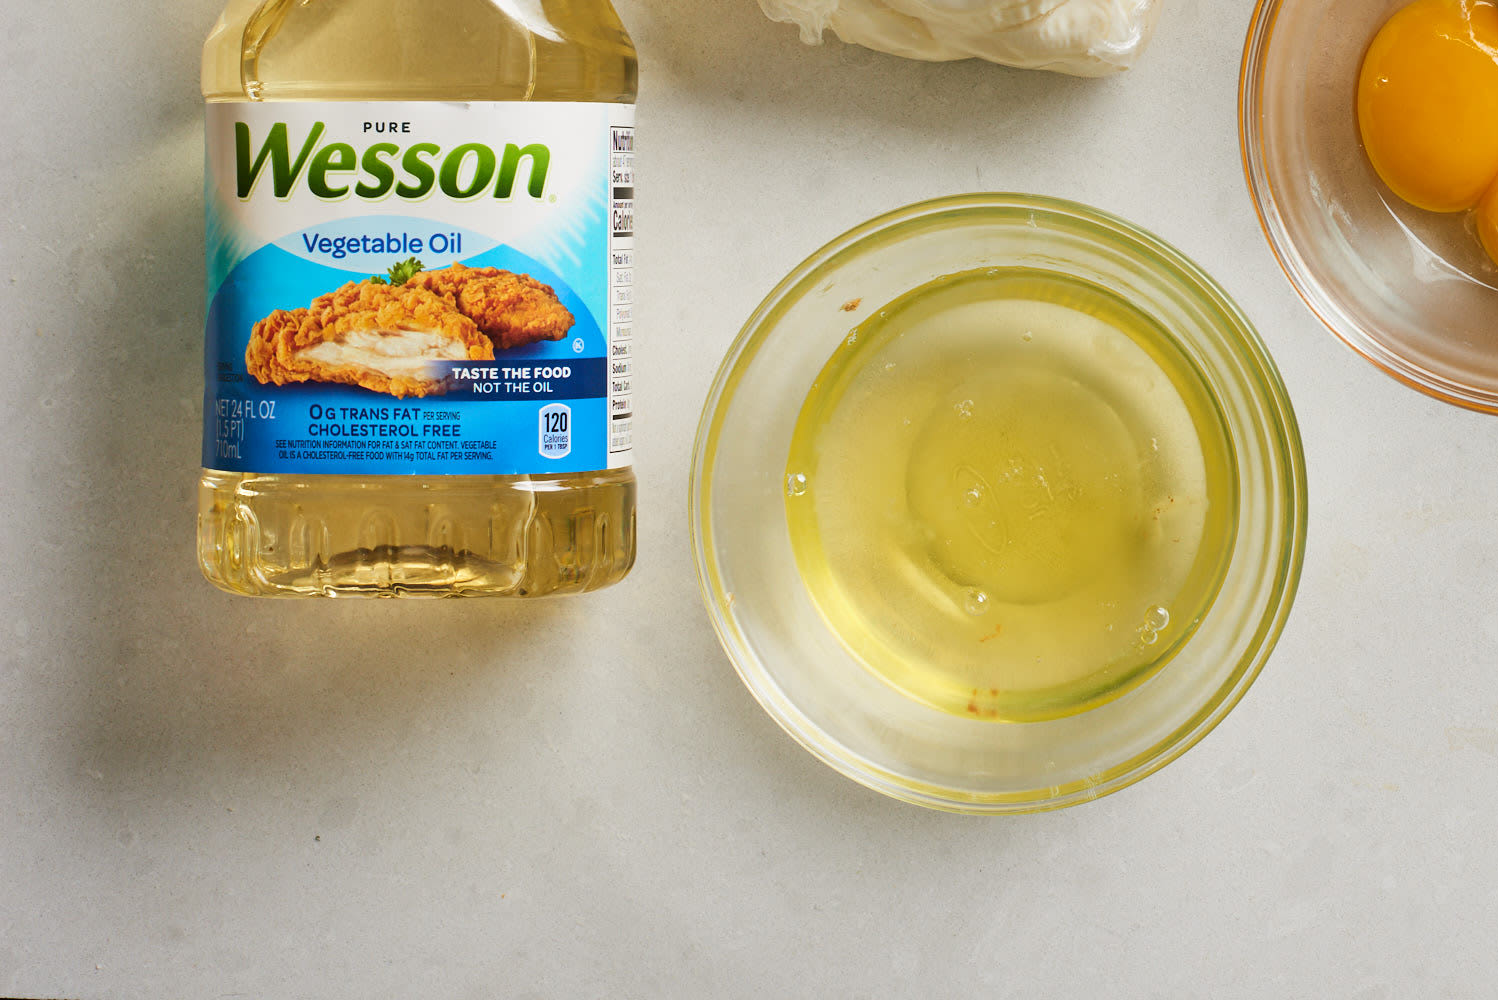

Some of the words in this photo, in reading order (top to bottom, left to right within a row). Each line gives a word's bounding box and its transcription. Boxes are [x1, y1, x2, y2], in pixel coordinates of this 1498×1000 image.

[363, 121, 411, 133] PURE
[234, 120, 552, 200] Wesson
[303, 231, 424, 259] Vegetable
[428, 231, 462, 254] Oil
[452, 367, 499, 380] TASTE
[501, 367, 531, 379] THE
[534, 366, 572, 379] FOOD
[473, 382, 501, 393] NOT
[504, 382, 530, 393] THE
[532, 381, 553, 393] OIL
[216, 399, 230, 417] NET
[231, 399, 243, 418] 24
[245, 400, 256, 418] FL
[259, 400, 276, 419] OZ
[339, 407, 389, 420] TRANS
[393, 407, 421, 420] FAT
[423, 411, 435, 421] PER
[436, 411, 461, 421] SERVING
[230, 418, 244, 440] PT)
[544, 412, 568, 433] 120
[308, 424, 419, 437] CHOLESTEROL
[423, 424, 461, 437] FREE
[275, 440, 287, 449] SEE
[287, 440, 322, 449] NUTRITION
[322, 440, 366, 449] INFORMATION
[367, 440, 381, 449] FOR
[382, 440, 395, 449] FAT
[400, 440, 413, 449] SAT
[414, 440, 426, 449] FAT
[460, 440, 497, 449] VEGETABLE
[543, 434, 568, 443] Calories
[215, 439, 242, 459] 710mL
[279, 451, 289, 460] OIL
[302, 451, 365, 460] CHOLESTEROL-FREE
[365, 451, 385, 460] FOOD
[386, 451, 402, 460] WITH
[415, 451, 436, 460] TOTAL
[437, 451, 448, 460] FAT
[450, 451, 463, 460] PER
[464, 451, 493, 460] SERVING.
